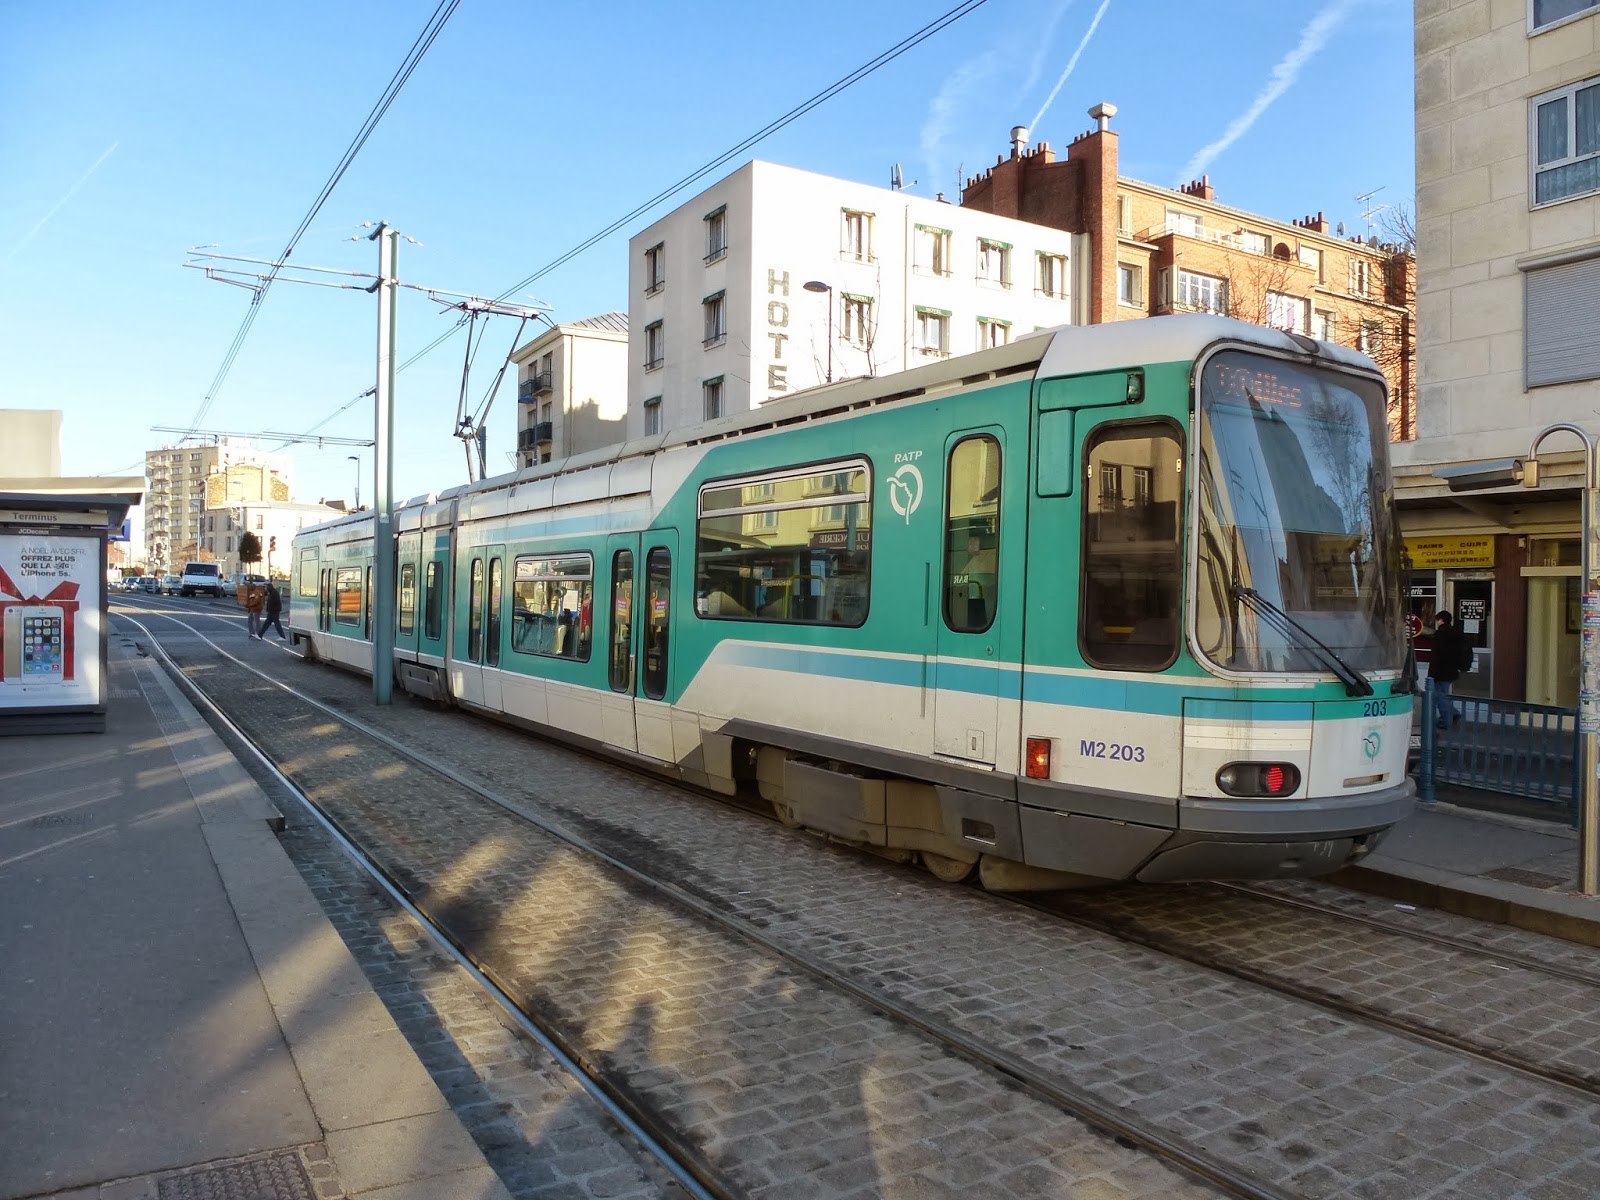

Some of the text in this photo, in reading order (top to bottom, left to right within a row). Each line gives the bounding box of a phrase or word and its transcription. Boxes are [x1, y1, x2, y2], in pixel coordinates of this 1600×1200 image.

[767, 268, 790, 400] HOTE
[894, 450, 923, 463] RATP
[13, 512, 58, 522] Terminus
[1421, 549, 1475, 557] FOURRURES
[21, 562, 38, 570] QUE
[1544, 558, 1557, 567] 116
[1363, 700, 1387, 717] 203
[1080, 739, 1145, 763] M2 203
